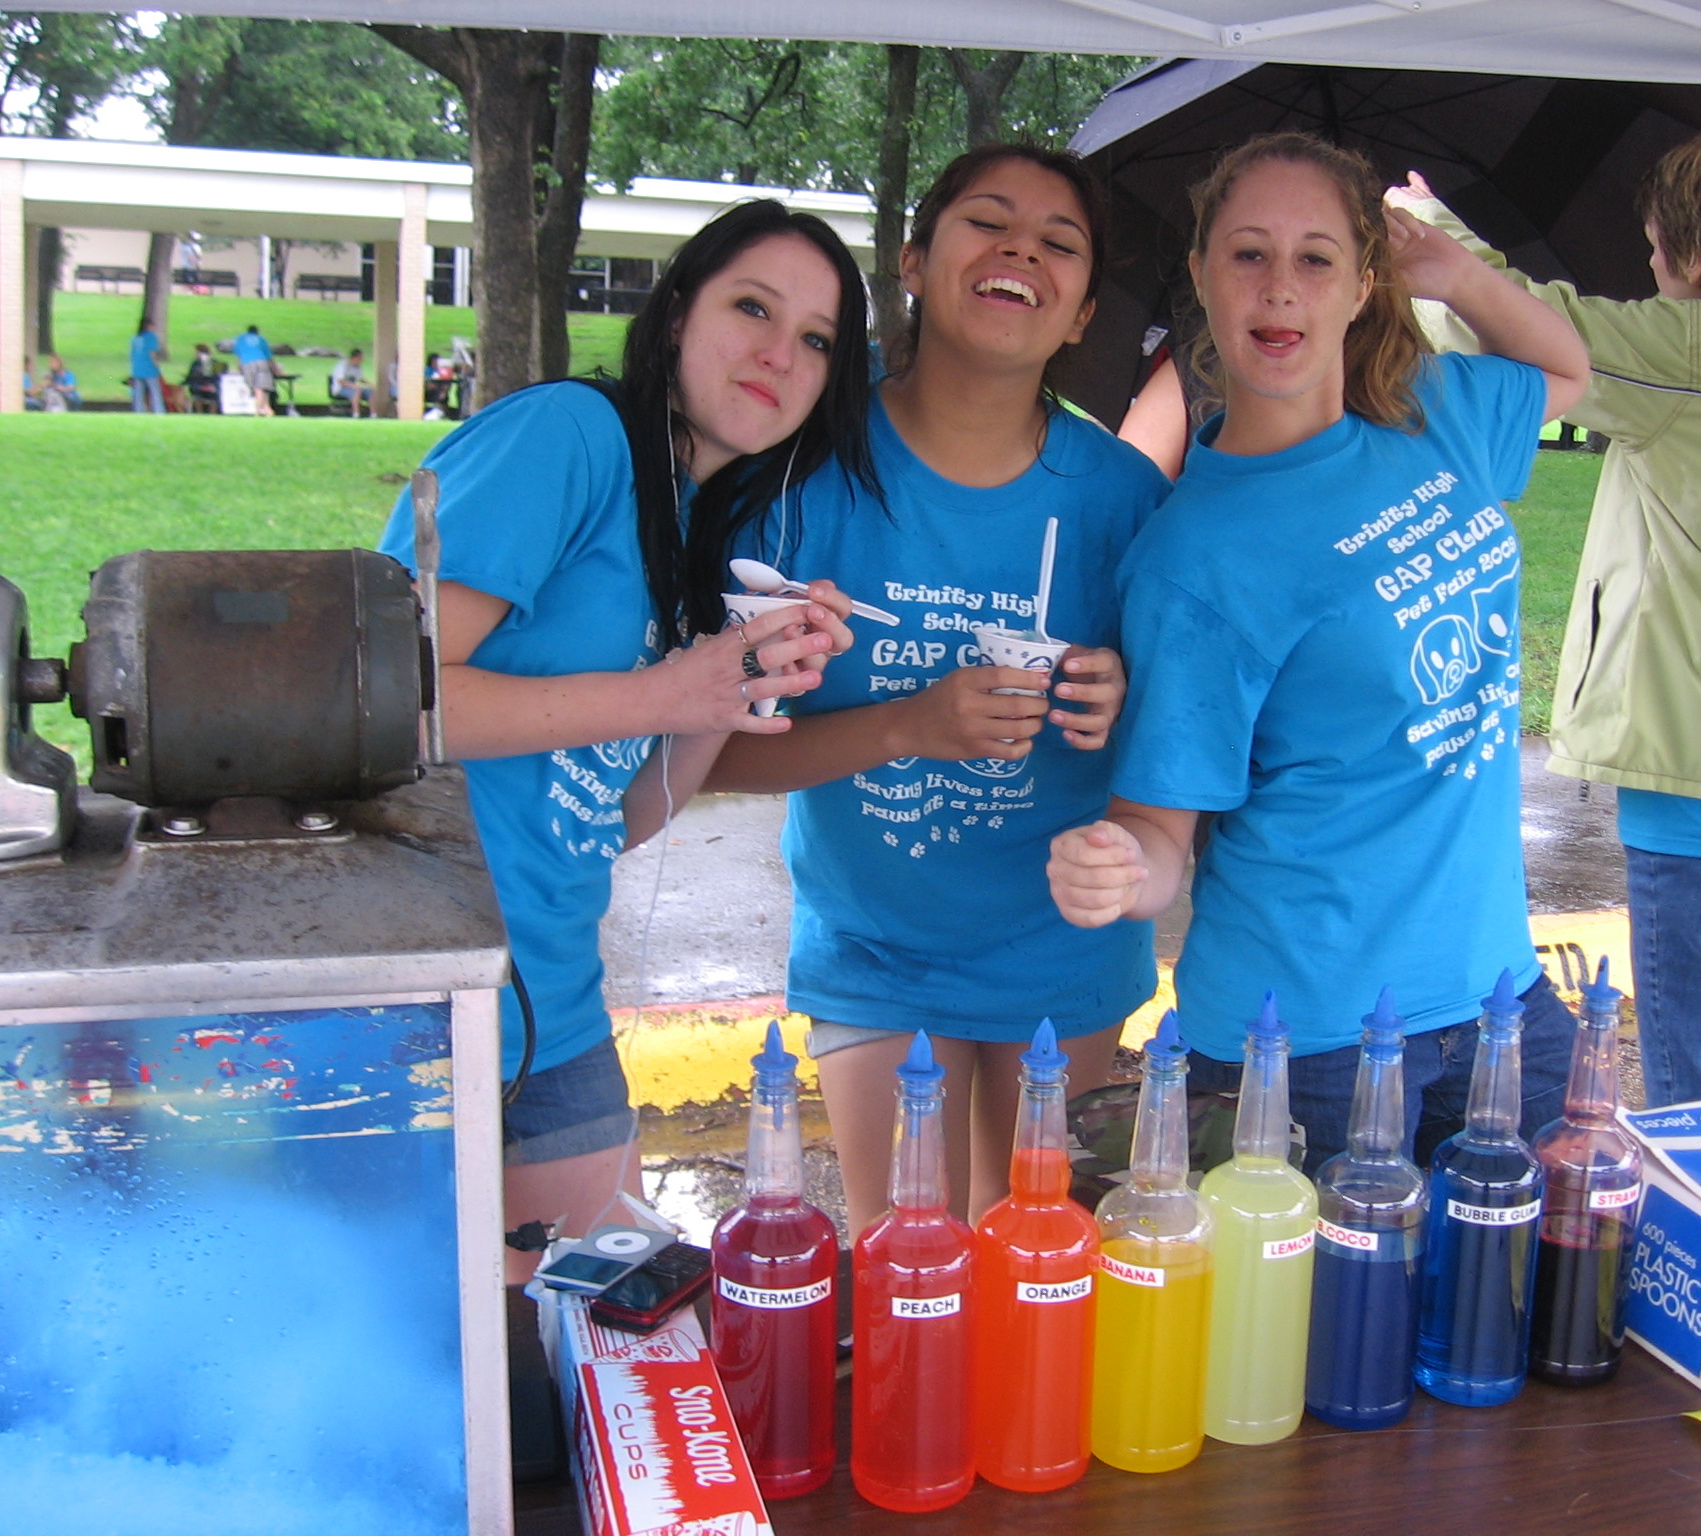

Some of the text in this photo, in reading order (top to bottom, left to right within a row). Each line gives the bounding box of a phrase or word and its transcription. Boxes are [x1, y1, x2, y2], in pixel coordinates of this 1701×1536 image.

[1334, 471, 1460, 555] Trinity High
[1387, 503, 1453, 554] School
[1373, 506, 1505, 602] GAP CLUB
[884, 581, 986, 610] Trinity
[1393, 594, 1433, 630] Pet
[1433, 567, 1477, 605] Fair
[871, 638, 947, 668] GAP
[868, 675, 917, 692] Pet
[1407, 702, 1478, 743] Saving
[852, 772, 923, 800] Saving
[1454, 1203, 1505, 1222] BUBBLE
[1642, 1221, 1697, 1270] 600 pieces
[1100, 1255, 1156, 1283] BANANA
[1635, 1241, 1701, 1305] PLASTIC
[724, 1280, 830, 1306] WATERMELON
[900, 1298, 955, 1316] PEACH
[1025, 1280, 1088, 1299] ORANGE
[1630, 1267, 1701, 1337] SPOONS
[613, 1402, 648, 1481] CUPS
